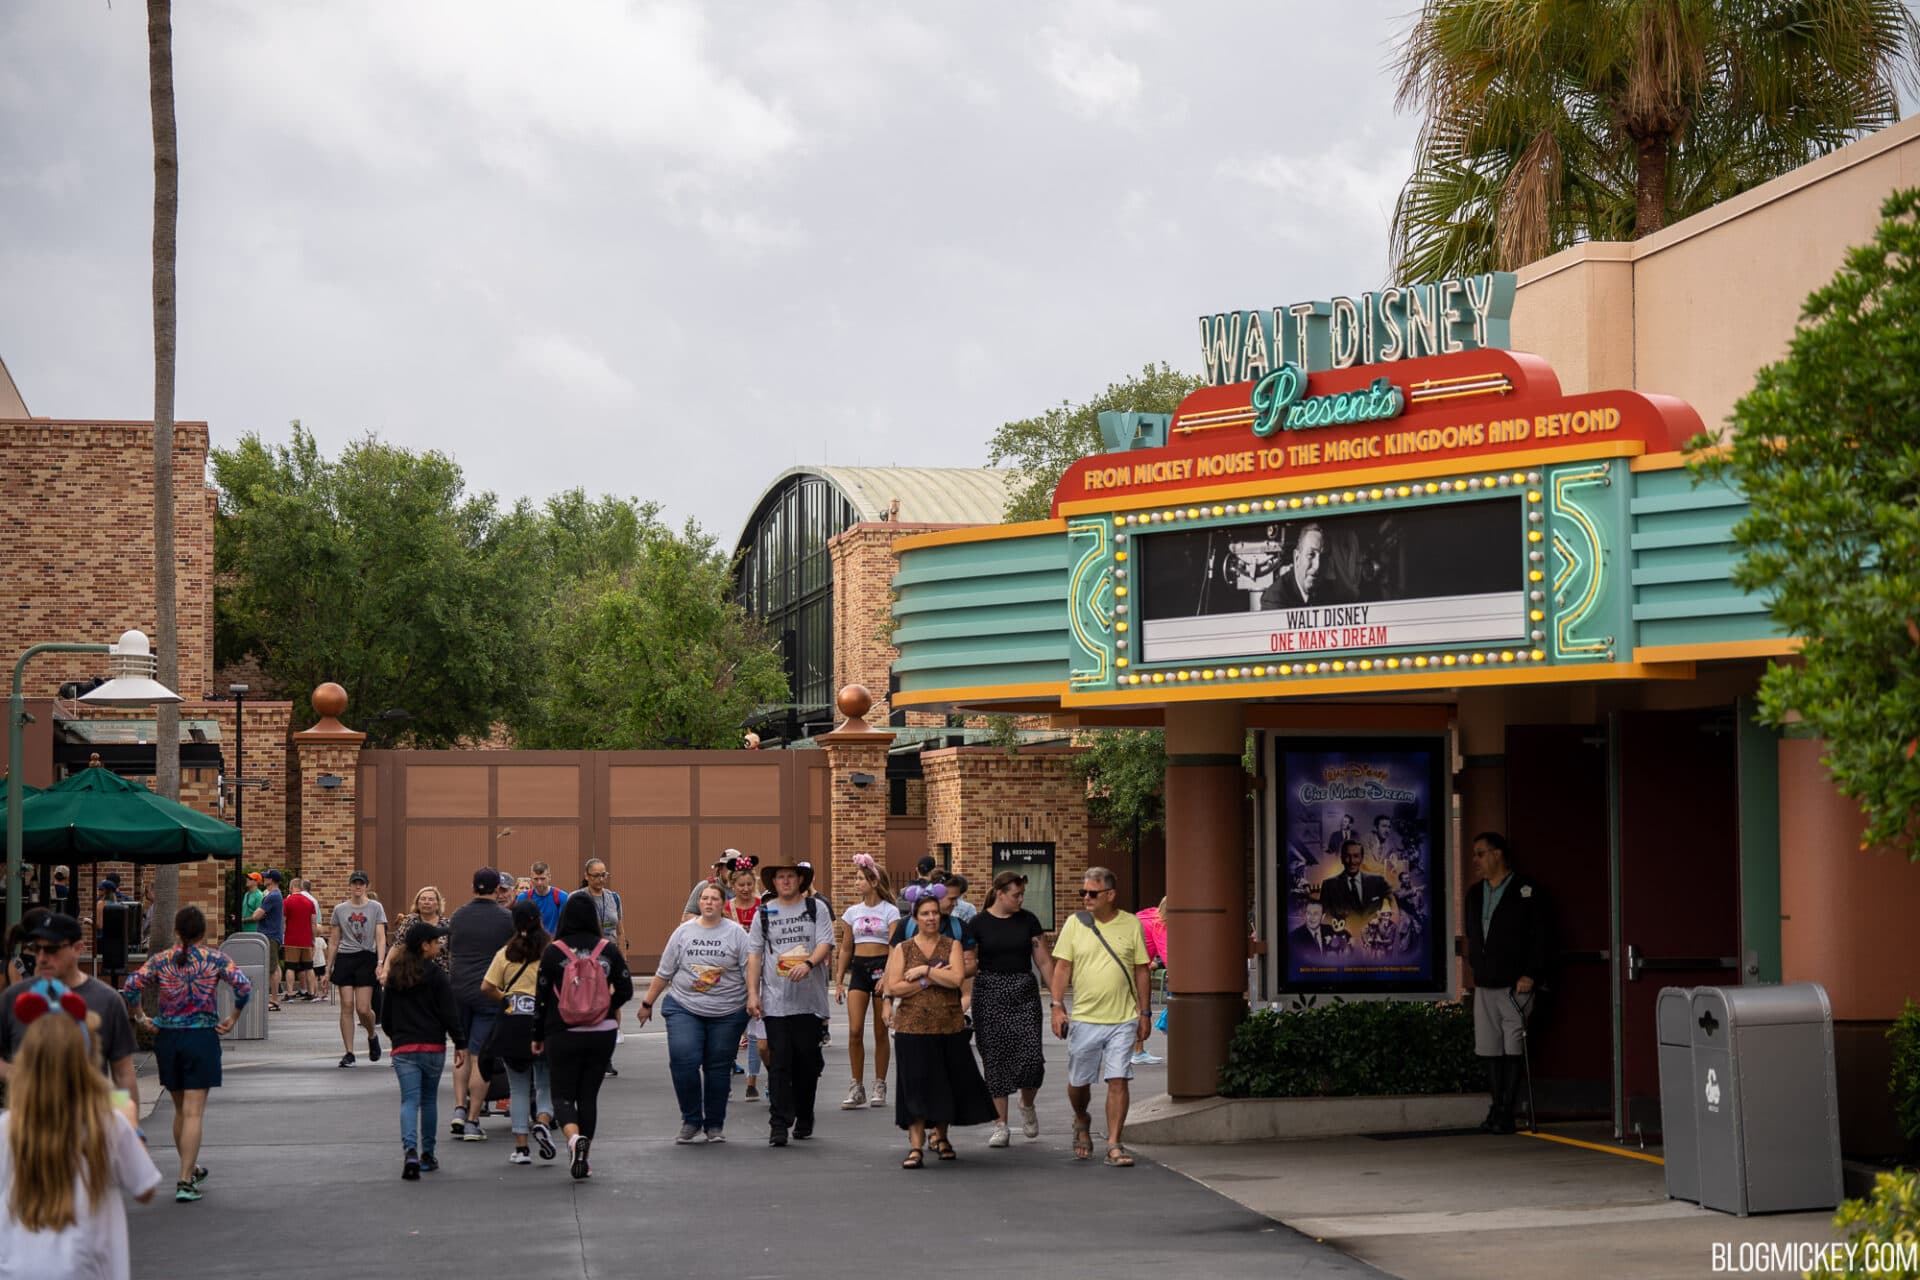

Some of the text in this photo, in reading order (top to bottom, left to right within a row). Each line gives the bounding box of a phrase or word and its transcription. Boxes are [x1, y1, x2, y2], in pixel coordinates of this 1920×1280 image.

[1199, 273, 1494, 386] WALT DISNEY
[1252, 362, 1402, 436] Presents
[1084, 407, 1621, 490] FROM MICKEY MOUSE TO THE MAGIC KINGDOMS AND BEYOND
[1287, 605, 1369, 629] WALT DISNEY
[1271, 625, 1388, 652] ONE MAN'S DREAM
[782, 925, 804, 934] EACH
[686, 949, 726, 957] WICHES
[691, 938, 722, 947] SAND
